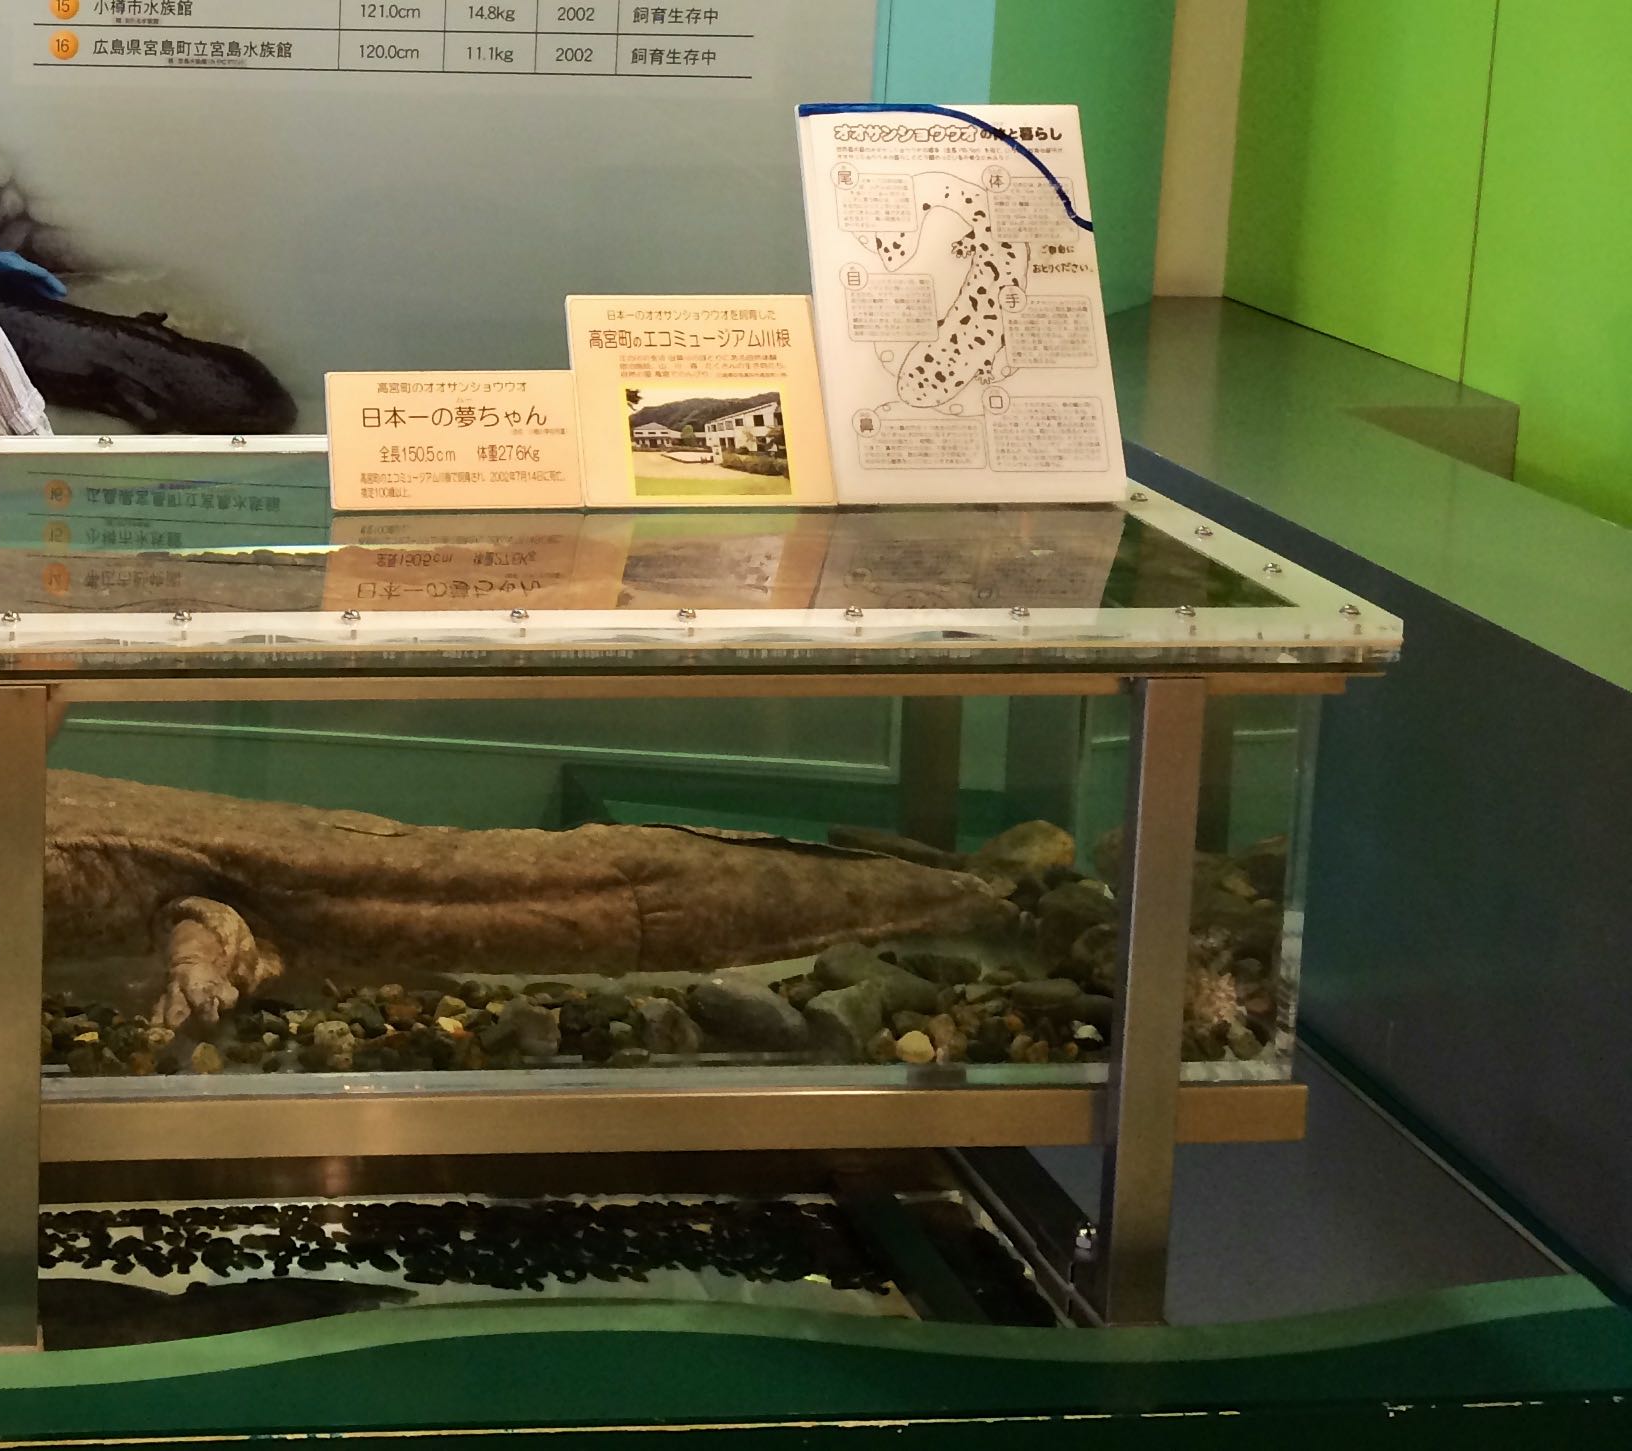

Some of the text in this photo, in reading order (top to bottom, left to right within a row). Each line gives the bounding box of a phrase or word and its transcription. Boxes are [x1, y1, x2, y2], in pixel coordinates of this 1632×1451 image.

[55, 0, 719, 25] 15 小樽市水族館 121.0cm 14.8kg 2002 飼育生存中
[55, 38, 717, 66] 16 広島県宮島町立宮島水族館 120.0cm 11.1kg 2002 飼育生存中
[838, 170, 853, 186] 尾
[989, 174, 1004, 188] 体
[1032, 262, 1094, 274] おとりください。
[847, 271, 860, 286] 目
[1006, 293, 1020, 309] 手
[588, 328, 792, 350] 高宮町のエコミュージアム川根
[377, 382, 528, 394] 高宮町のオオサンショウウオ
[989, 395, 1003, 410] 口
[362, 405, 548, 428] 日本一の夢ちゃん
